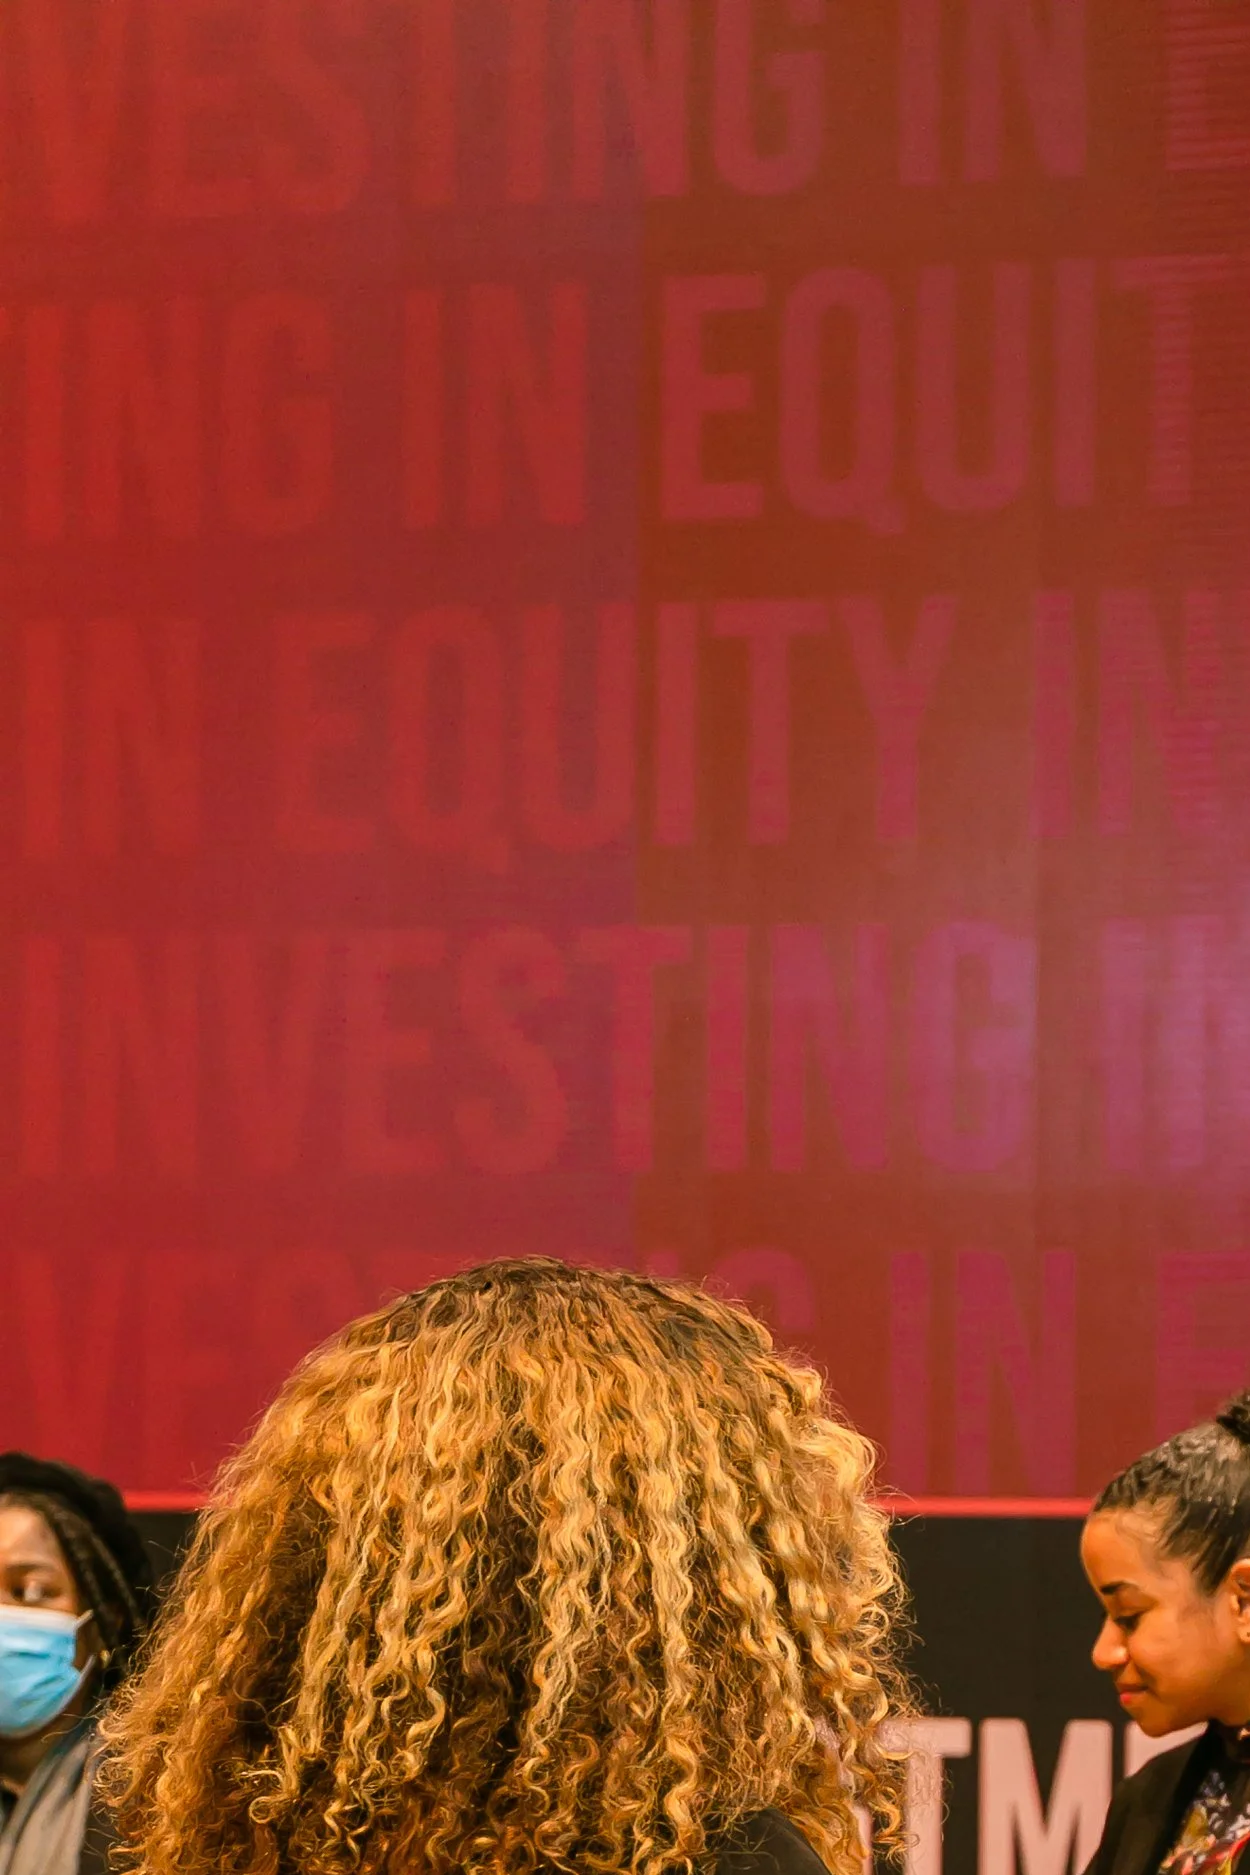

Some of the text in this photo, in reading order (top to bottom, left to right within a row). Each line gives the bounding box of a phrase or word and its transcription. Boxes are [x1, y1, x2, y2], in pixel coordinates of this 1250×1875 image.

[403, 281, 588, 528] IN
[22, 614, 200, 860] IN
[273, 595, 957, 874] EQUITY
[20, 920, 1030, 1176] INVESTING
[891, 1248, 1078, 1490] IN
